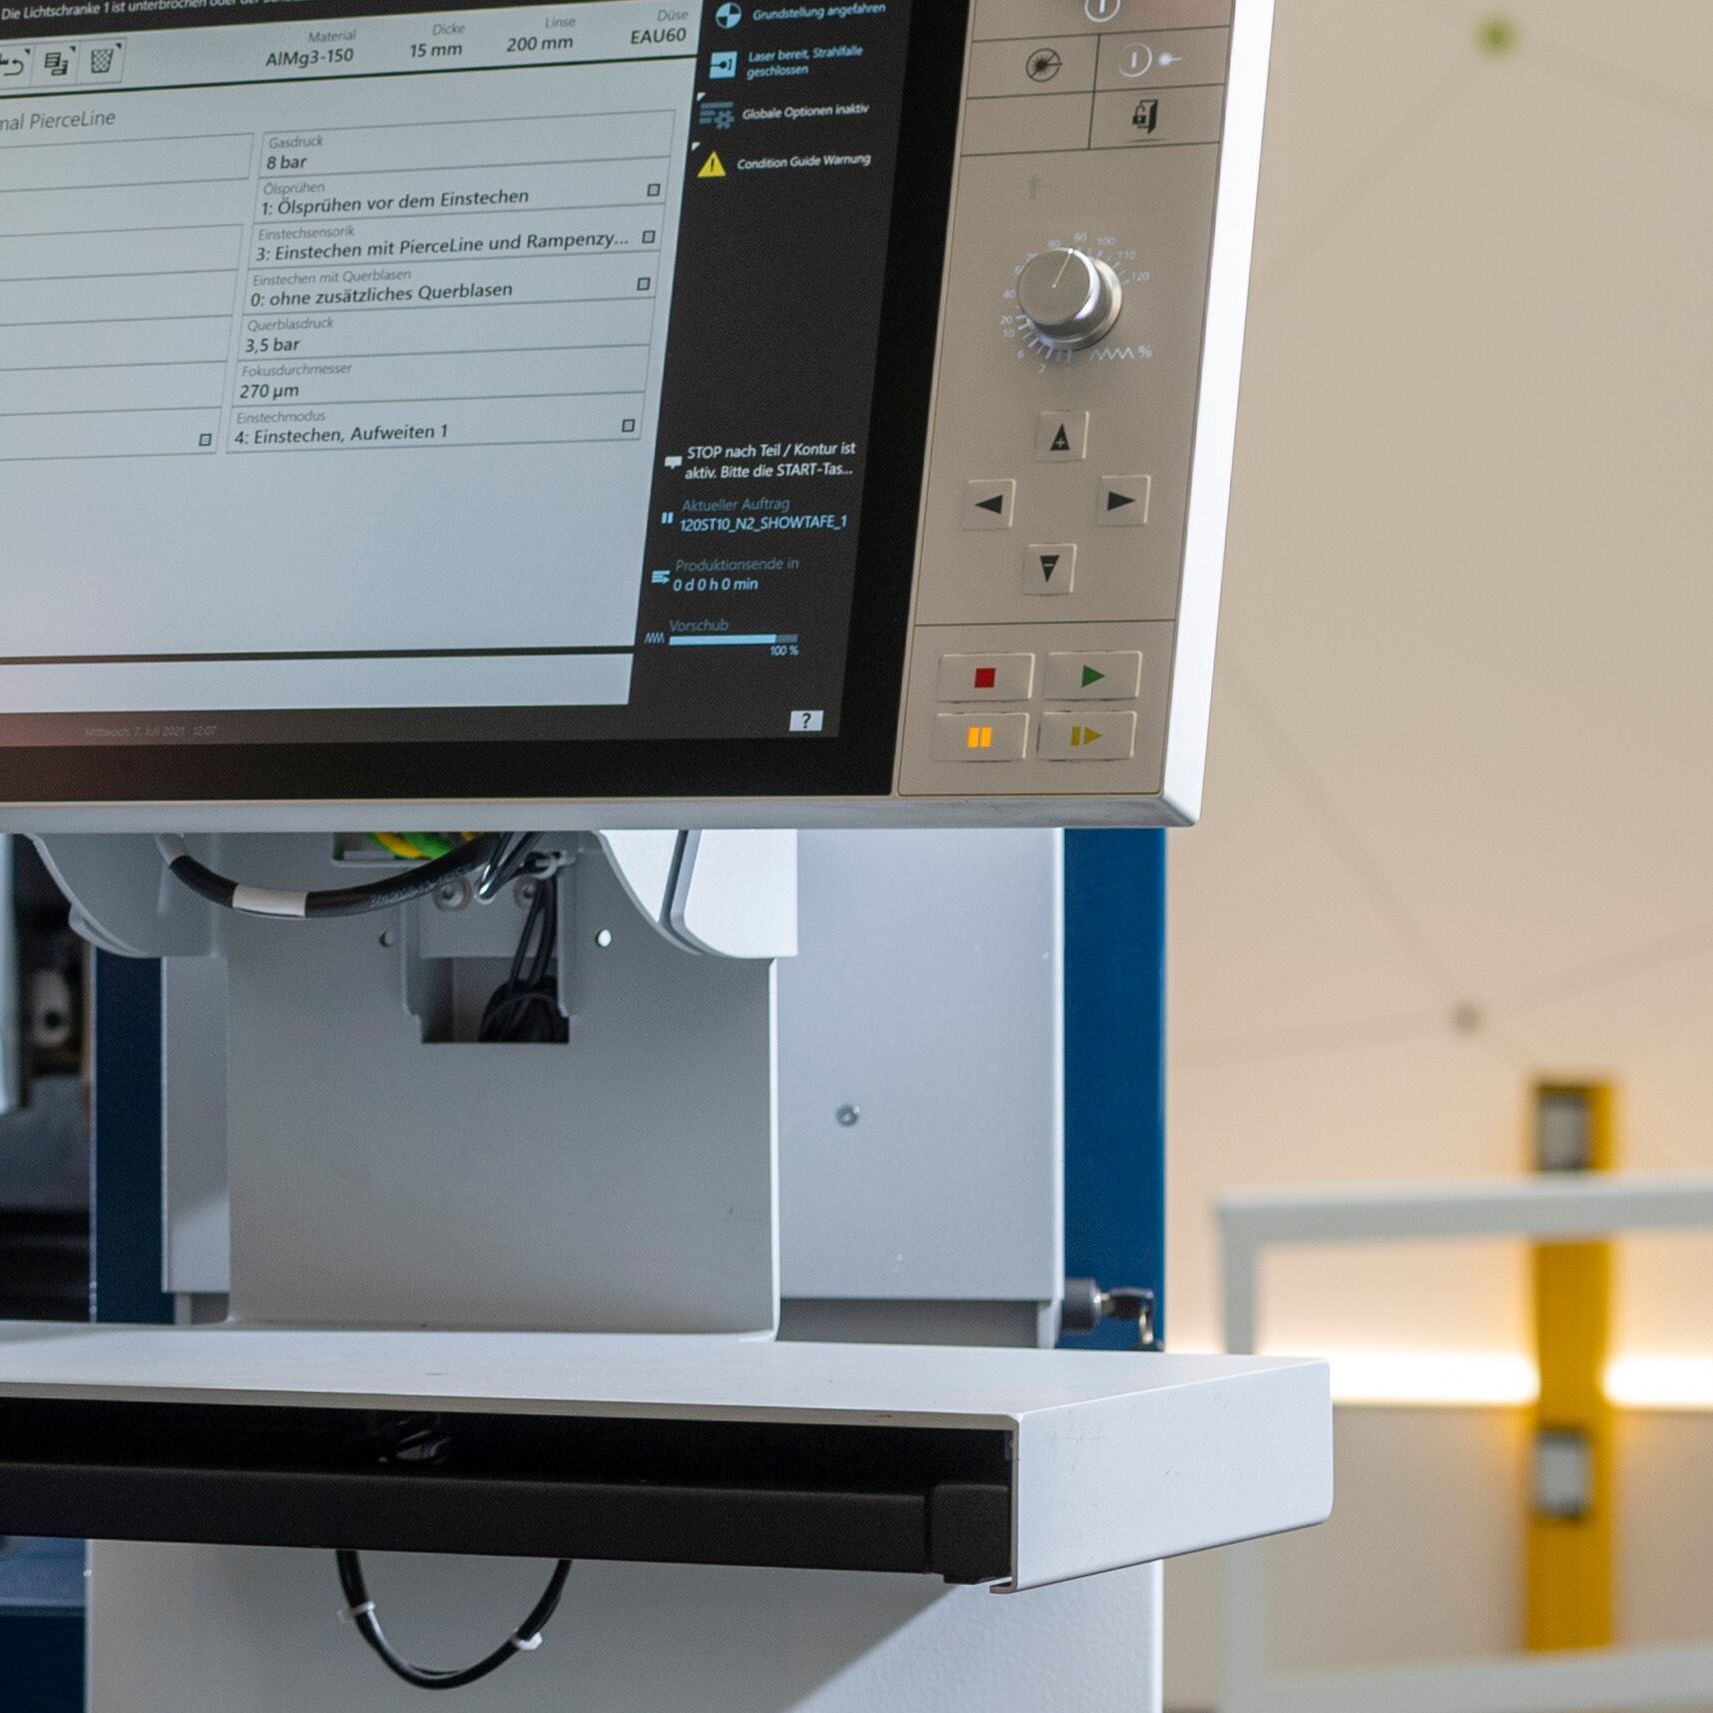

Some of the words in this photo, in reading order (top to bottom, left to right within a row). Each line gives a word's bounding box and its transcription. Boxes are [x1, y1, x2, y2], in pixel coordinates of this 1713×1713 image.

[1, 6, 21, 21] Die
[24, 1, 101, 19] Lichtschranke
[104, 2, 110, 14] 1
[112, 0, 126, 13] ist
[657, 8, 689, 22] Düse
[753, 7, 824, 21] Grundstellung
[827, 3, 886, 18] angefahren
[432, 22, 465, 35] Dicke
[545, 16, 576, 29] Linse
[308, 29, 356, 43] Material
[630, 28, 687, 45] EAU60
[410, 43, 427, 58] 15
[431, 44, 463, 57] mm
[507, 36, 537, 53] 200
[541, 37, 574, 50] mm
[265, 48, 354, 70] AlMg3-150
[749, 51, 775, 62] Laser
[813, 45, 863, 59] Strahlfalle
[746, 65, 809, 80] geschlossen
[743, 105, 782, 120] Globale
[784, 104, 833, 120] Optionen
[835, 102, 869, 115] inaktiv
[30, 110, 116, 130] PierceLine
[268, 135, 323, 149] Gasdruck
[266, 155, 277, 170] 8
[280, 154, 307, 169] bar
[737, 158, 787, 170] Condition
[790, 155, 821, 167] Guide
[823, 154, 871, 166] Warnung
[263, 180, 325, 199] Ölsprühen
[261, 201, 273, 216] 1:
[277, 197, 362, 220] Ölsprühen
[366, 198, 394, 210] vor
[398, 192, 435, 209] dem
[440, 188, 529, 208] Einstechen
[258, 225, 355, 241] Einstechsensorik
[256, 246, 270, 262] 3:
[275, 241, 362, 260] Einstechen
[367, 240, 394, 256] mit
[400, 236, 483, 254] PierceLine
[488, 234, 522, 251] und
[526, 231, 629, 254] Rampenzy...
[1098, 237, 1115, 246] 100
[1118, 251, 1136, 260] 110
[253, 272, 315, 287] Einstechen
[320, 271, 339, 284] mit
[343, 268, 412, 285] Querblasen
[1132, 272, 1150, 282] 120
[250, 293, 265, 308] 0:
[269, 290, 311, 306] ohne
[315, 286, 413, 304] zusätzliches
[418, 282, 513, 302] Querblasen
[247, 317, 334, 332] Querblasdruck
[245, 338, 269, 354] 3,5
[273, 337, 300, 352] bar
[242, 363, 353, 378] Fokusdurchmesser
[240, 384, 269, 399] 270
[236, 410, 326, 424] Einstechmodus
[234, 430, 249, 445] 4:
[253, 427, 345, 445] Einstechen,
[350, 424, 435, 442] Aufweiten
[441, 424, 448, 438] 1
[687, 447, 722, 460] STOP
[725, 445, 756, 458] nach
[760, 444, 780, 456] Teil
[783, 444, 791, 457] /
[794, 443, 837, 456] Kontur
[840, 442, 856, 454] ist
[685, 467, 717, 480] aktiv.
[720, 466, 749, 478] Bitte
[753, 465, 773, 477] die
[682, 499, 738, 512] Aktueller
[742, 498, 790, 514] Auftrag
[675, 557, 783, 572] Produktionsende
[787, 558, 799, 569] in
[673, 580, 682, 592] 0
[685, 578, 694, 591] d
[698, 579, 706, 591] 0
[709, 577, 718, 590] h
[722, 578, 731, 590] 0
[734, 577, 758, 590] min
[670, 619, 729, 632] Vorschub
[770, 645, 787, 656] 100
[789, 645, 799, 656] %
[802, 713, 812, 729] ?
